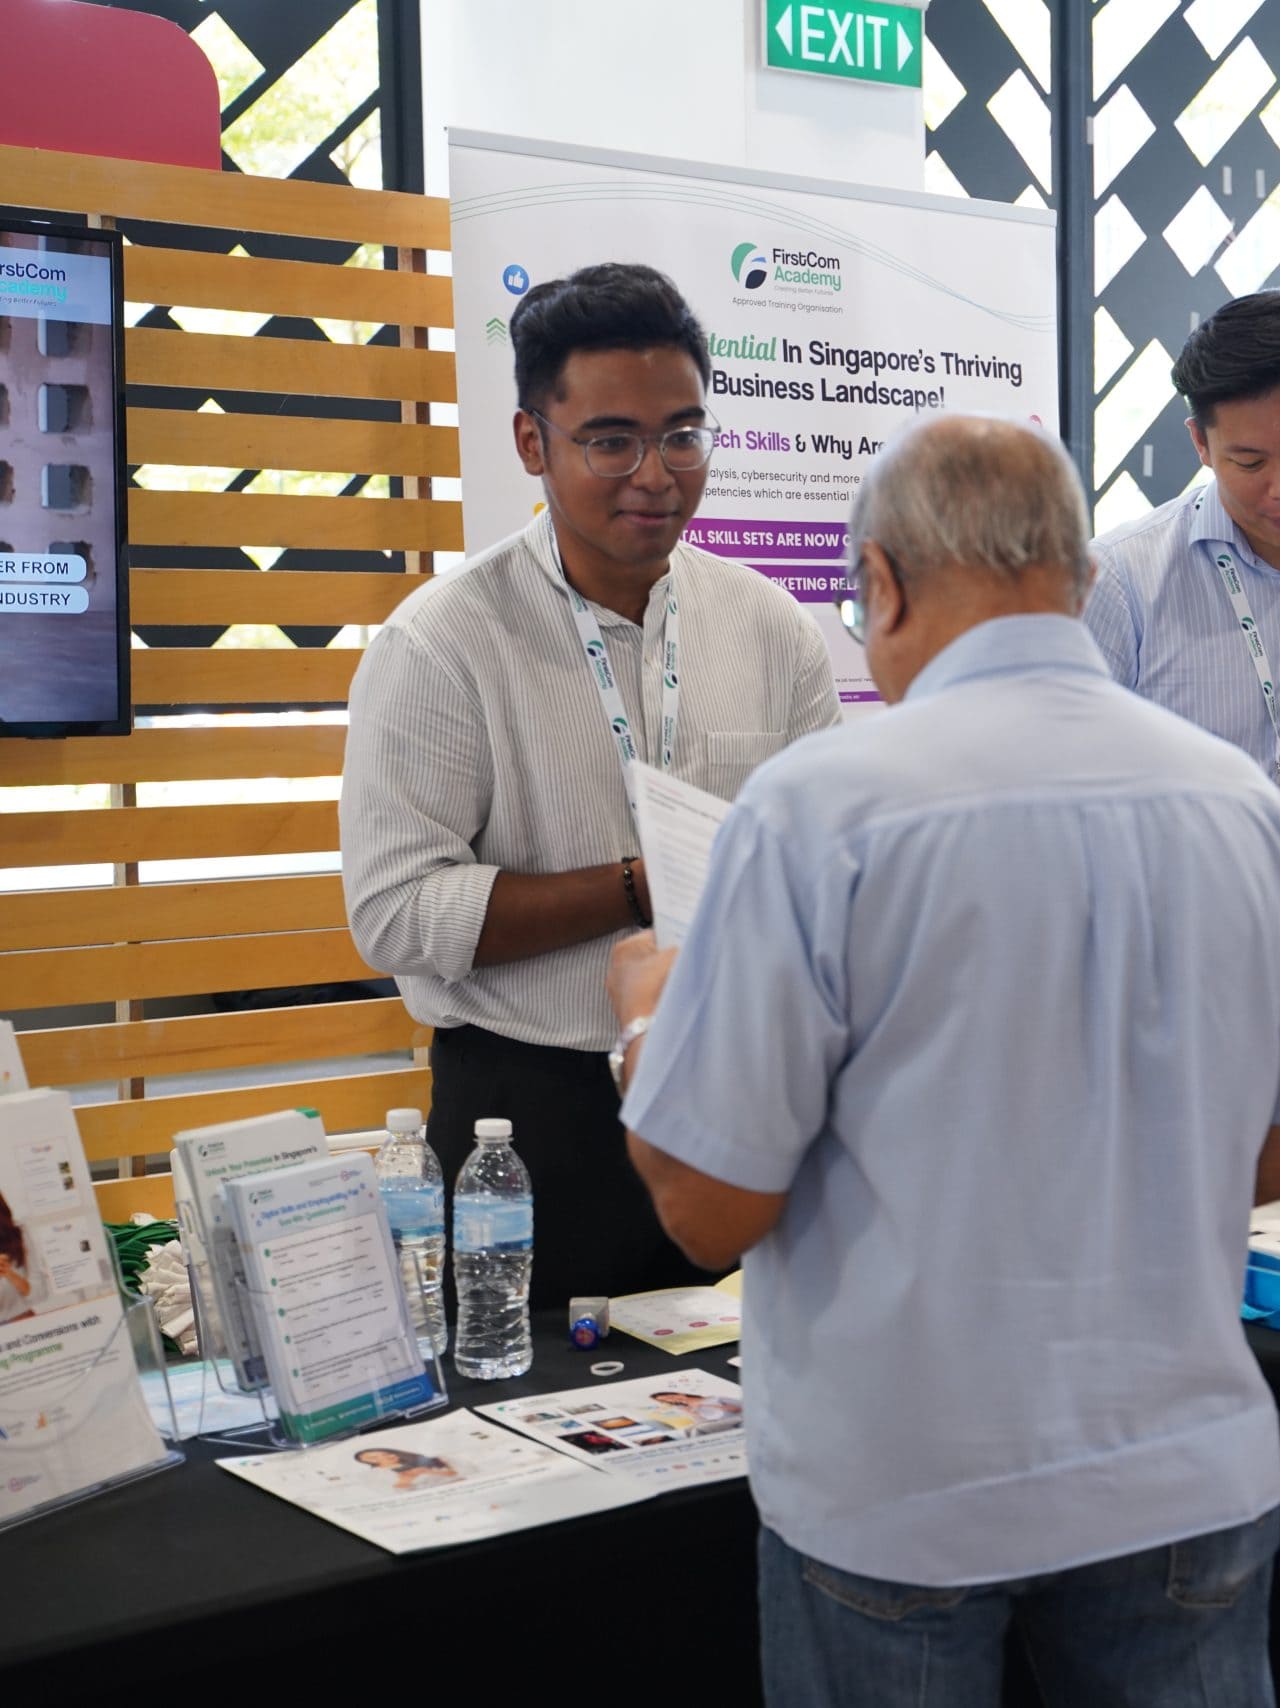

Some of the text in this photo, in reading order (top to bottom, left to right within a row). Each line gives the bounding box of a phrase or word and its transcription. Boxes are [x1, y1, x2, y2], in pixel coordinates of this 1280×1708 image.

[800, 5, 889, 70] EXIT
[773, 248, 840, 270] FirstCom
[0, 262, 66, 282] rstCom
[774, 266, 841, 291] Academy
[732, 297, 843, 314] Approved Training Organisation
[708, 332, 1023, 387] tential In Singapore’s Thriving
[712, 370, 945, 413] Business Landscape!
[745, 430, 791, 452] Skills
[795, 432, 806, 452] &
[811, 434, 853, 460] Why
[741, 470, 808, 485] cybersecurity
[810, 472, 830, 484] and
[833, 475, 860, 485] more
[705, 486, 752, 501] petencies
[754, 488, 783, 500] which
[785, 491, 802, 501] are
[804, 489, 850, 501] essential
[707, 531, 741, 545] SKILL
[743, 532, 774, 546] SETS
[776, 533, 802, 547] ARE
[804, 533, 839, 547] NOW
[22, 561, 69, 575] FROM
